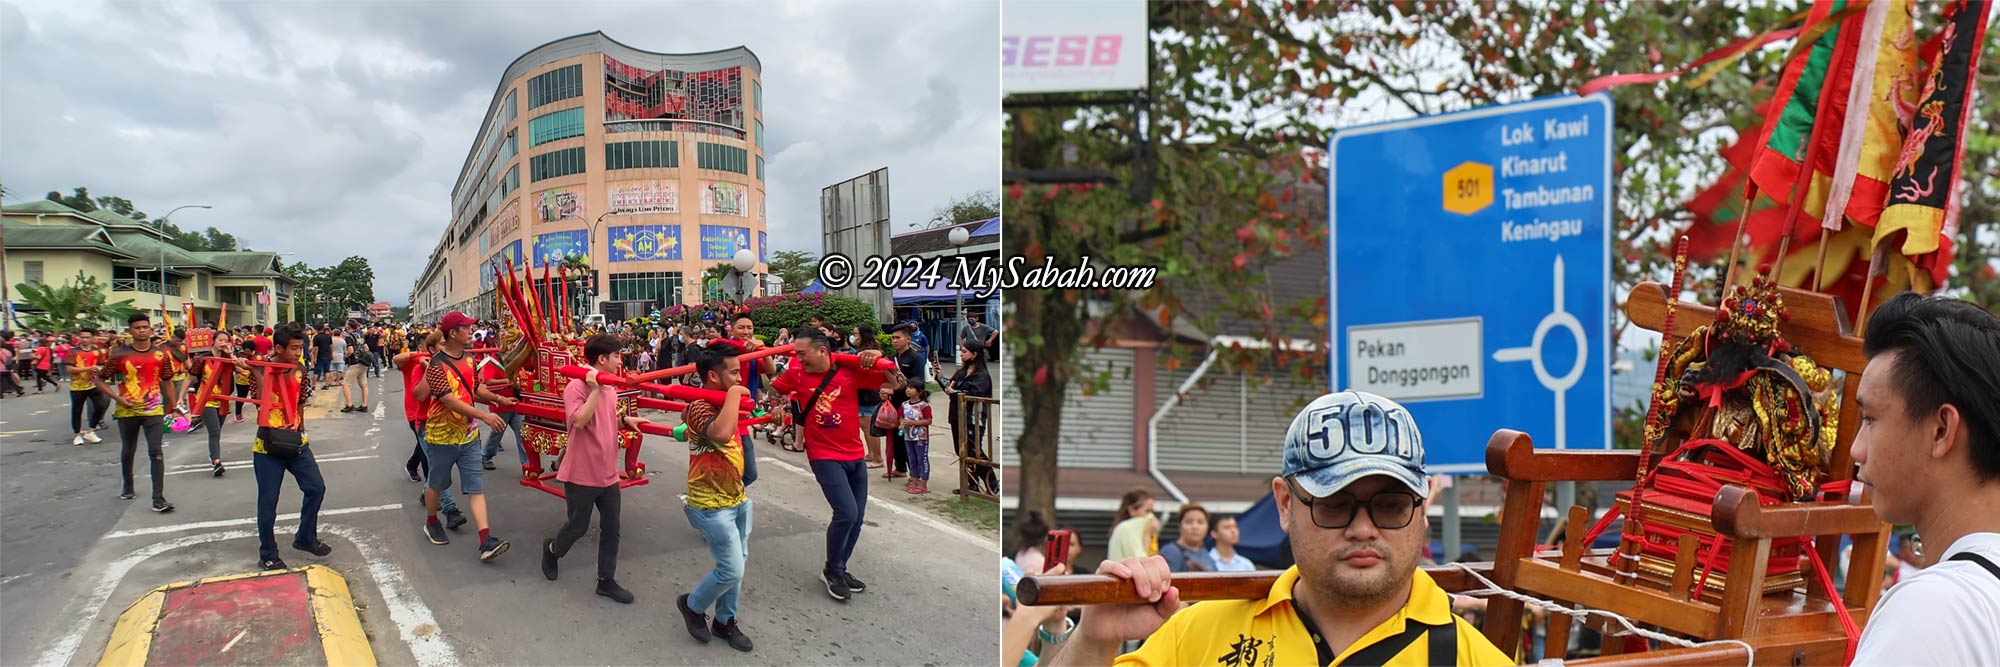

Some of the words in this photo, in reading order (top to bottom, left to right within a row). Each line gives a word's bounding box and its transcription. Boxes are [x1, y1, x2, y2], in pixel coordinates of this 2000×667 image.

[1501, 123, 1535, 147] Lok
[1543, 115, 1589, 141] Kawi
[1501, 151, 1567, 179] Kinarut
[1456, 178, 1481, 199] 501
[1502, 184, 1594, 210] Tambunan
[1501, 218, 1582, 243] Keningau
[638, 241, 652, 252] AM
[1357, 339, 1405, 359] Pekan
[1367, 362, 1470, 386] Donggongon
[1307, 401, 1413, 461] 501
